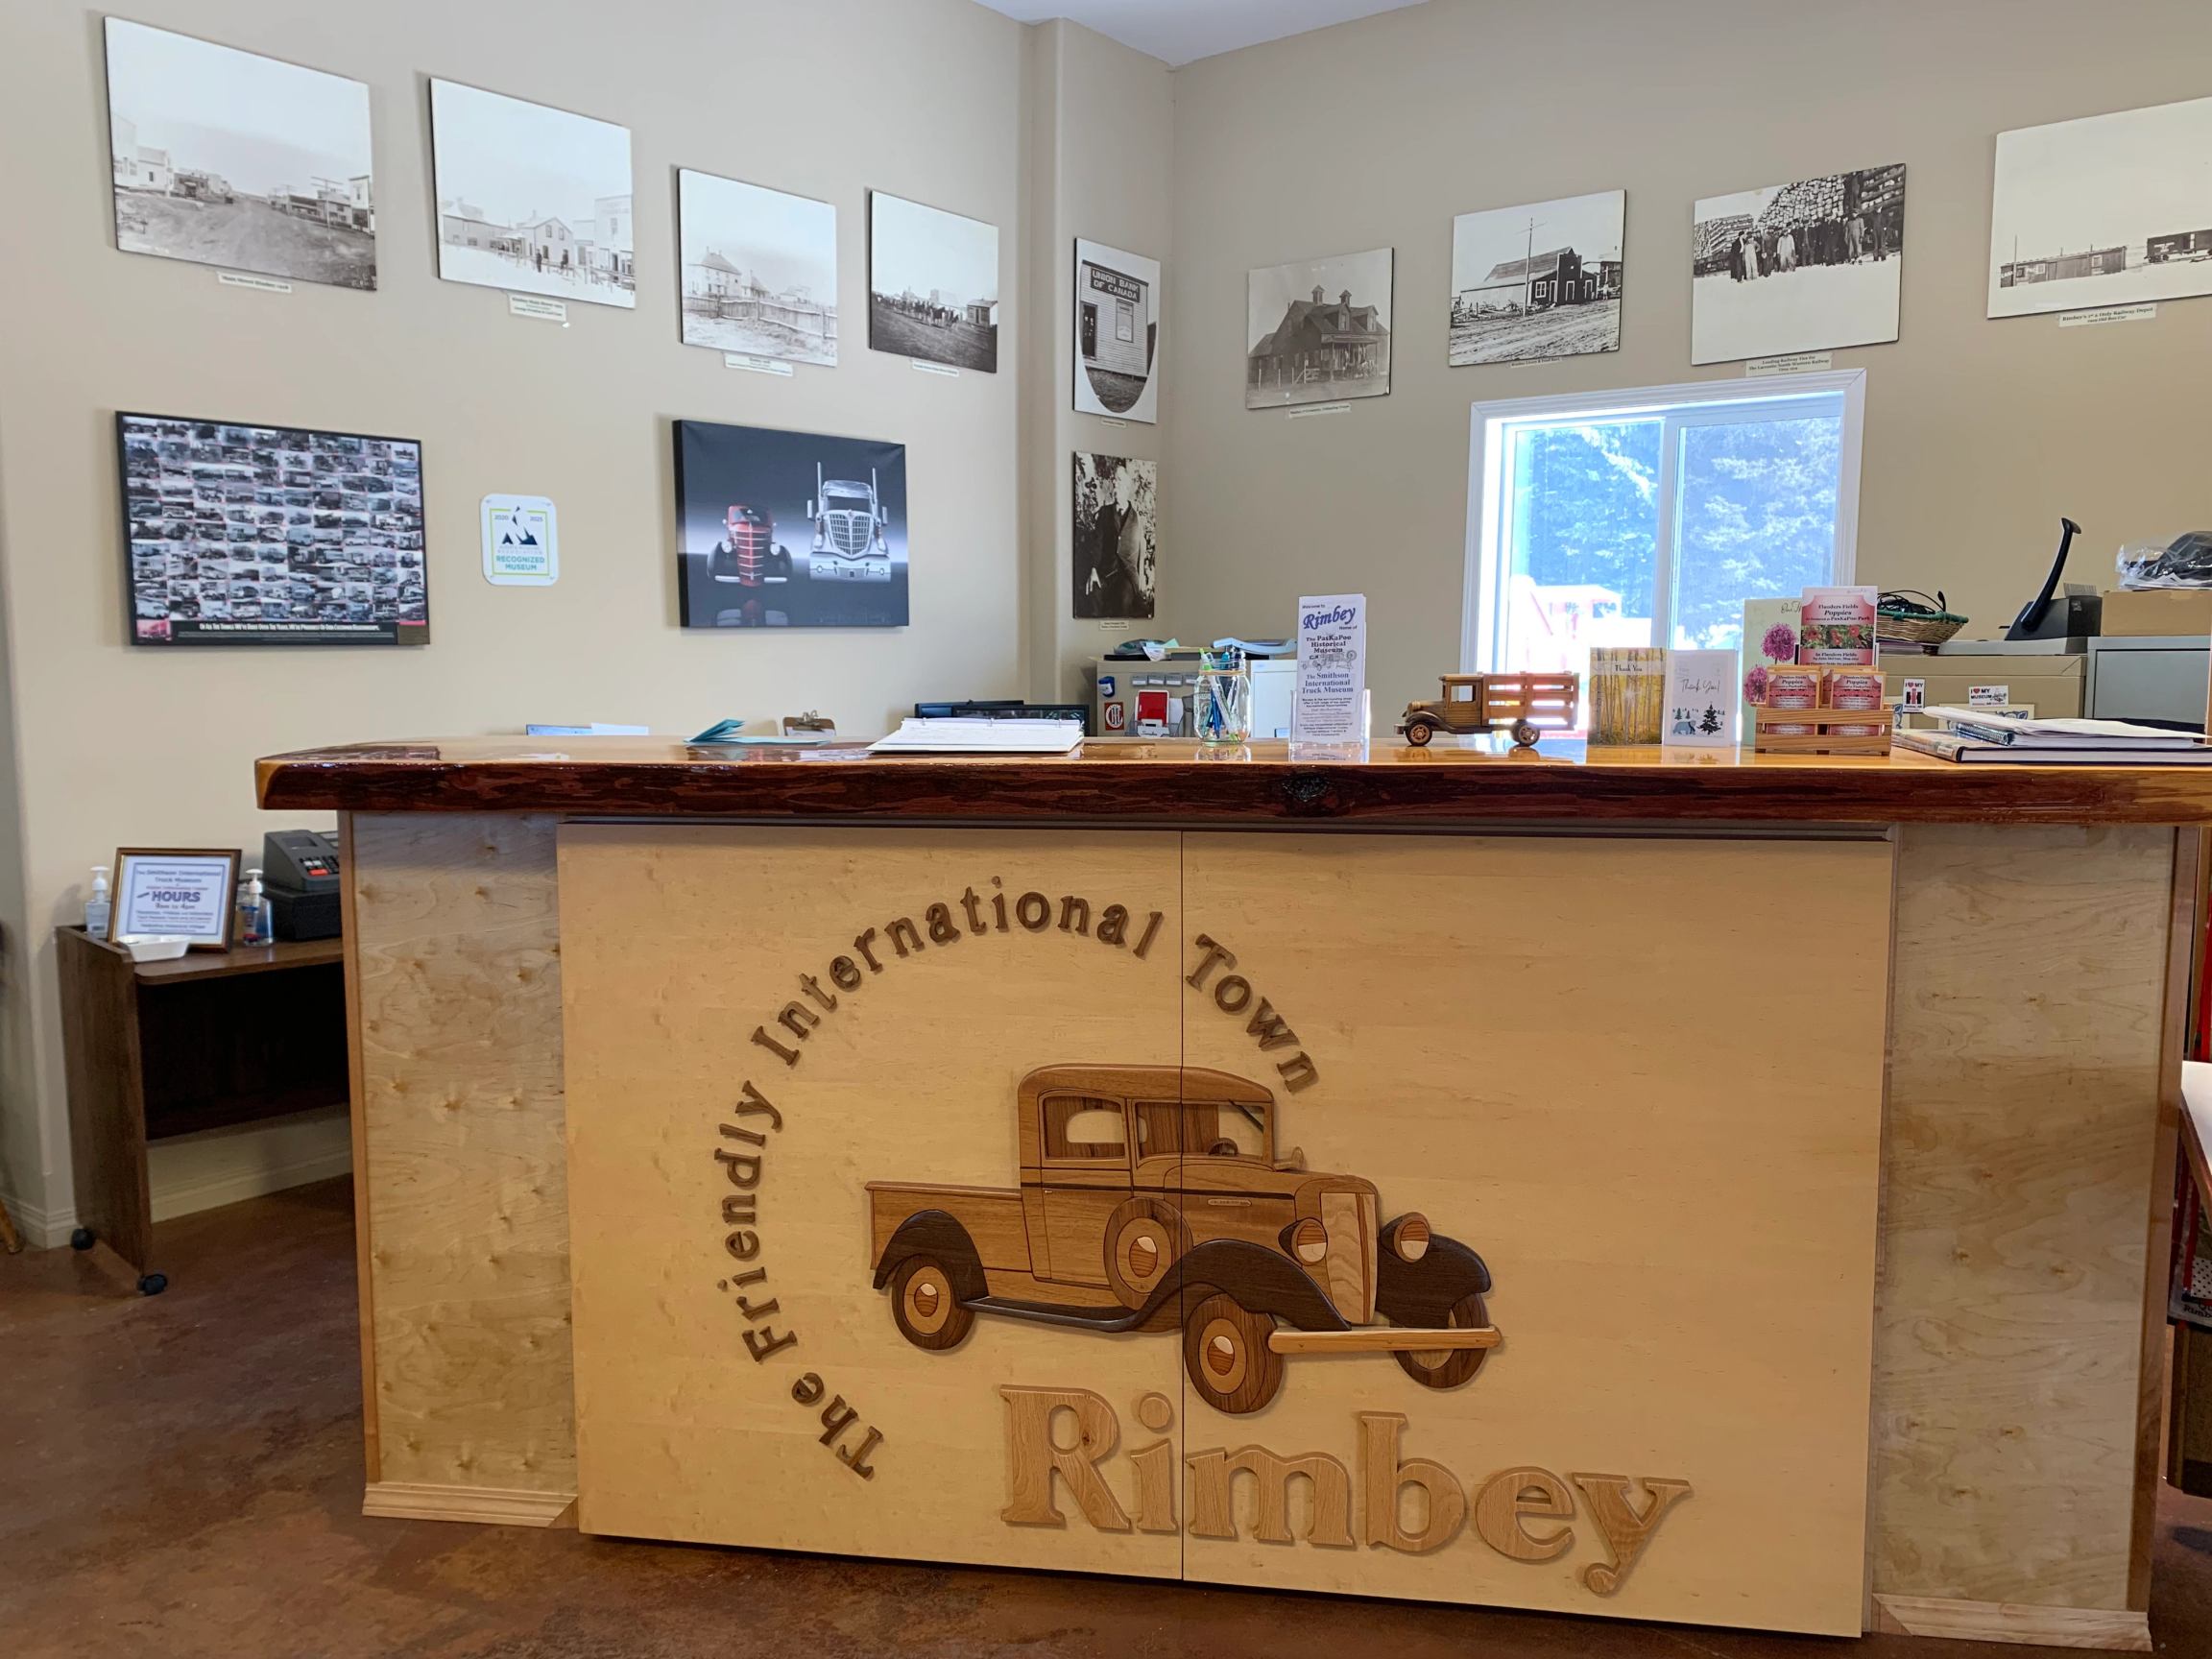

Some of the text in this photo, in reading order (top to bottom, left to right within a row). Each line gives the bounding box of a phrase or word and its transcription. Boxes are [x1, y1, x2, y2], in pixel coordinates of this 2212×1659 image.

[1093, 270, 1117, 284] UNION
[1094, 279, 1139, 301] OF CANADA
[495, 555, 545, 564] RECOGNIZED
[1303, 605, 1356, 630] Rimbey
[1305, 679, 1351, 687] International
[1680, 678, 1700, 693] Thank
[152, 891, 201, 902] HOURS
[714, 876, 1319, 1481] The Friendly International Town
[998, 1383, 1693, 1597] Rimbey
